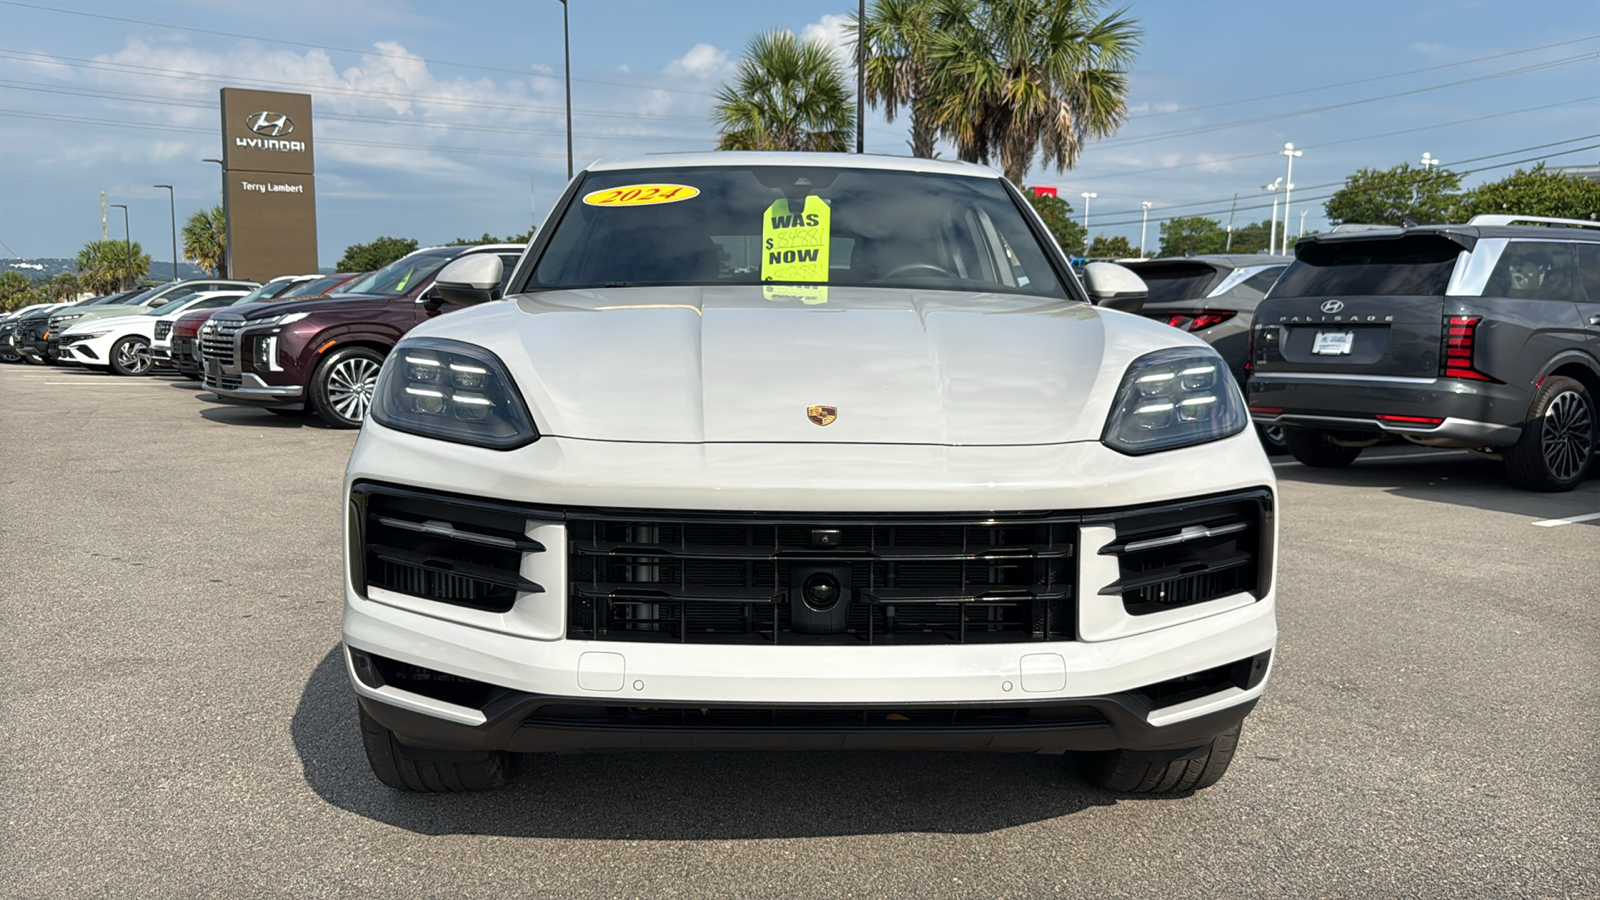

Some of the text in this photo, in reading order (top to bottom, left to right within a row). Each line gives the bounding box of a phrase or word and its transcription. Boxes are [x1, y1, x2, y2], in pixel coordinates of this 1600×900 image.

[235, 137, 306, 152] HYUNDAI
[241, 181, 304, 193] Terry Lambert
[598, 187, 684, 204] 2024
[771, 213, 820, 230] WAS
[765, 238, 774, 251] $
[769, 249, 819, 265] NOW
